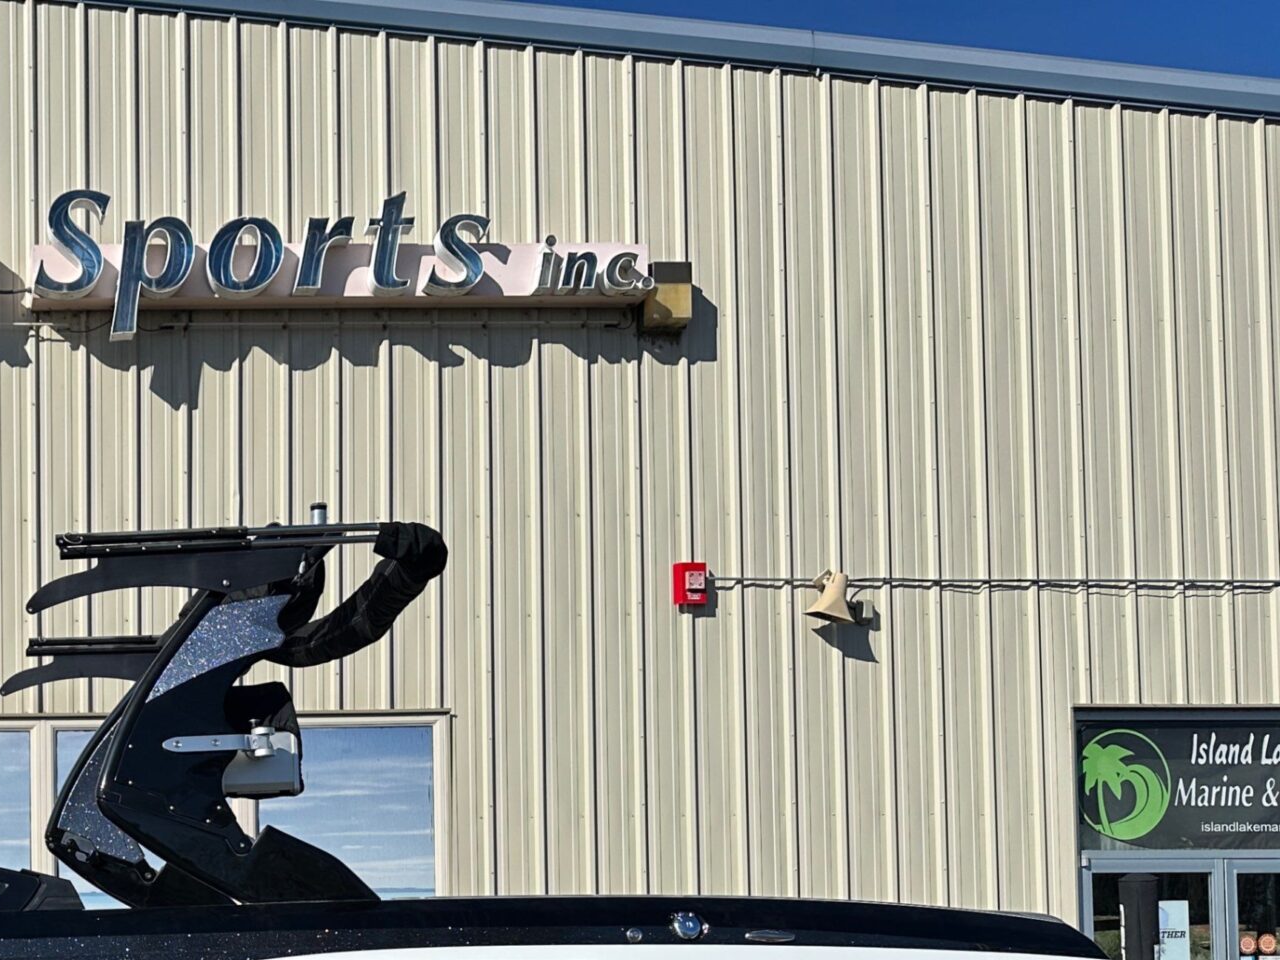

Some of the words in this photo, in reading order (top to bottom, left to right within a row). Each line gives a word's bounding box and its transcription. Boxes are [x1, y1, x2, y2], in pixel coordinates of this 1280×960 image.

[31, 188, 491, 341] Sports
[535, 234, 655, 297] inc.
[1190, 731, 1255, 765] Island
[1174, 774, 1254, 807] Marine
[1261, 777, 1280, 807] &
[1160, 930, 1187, 939] THER
